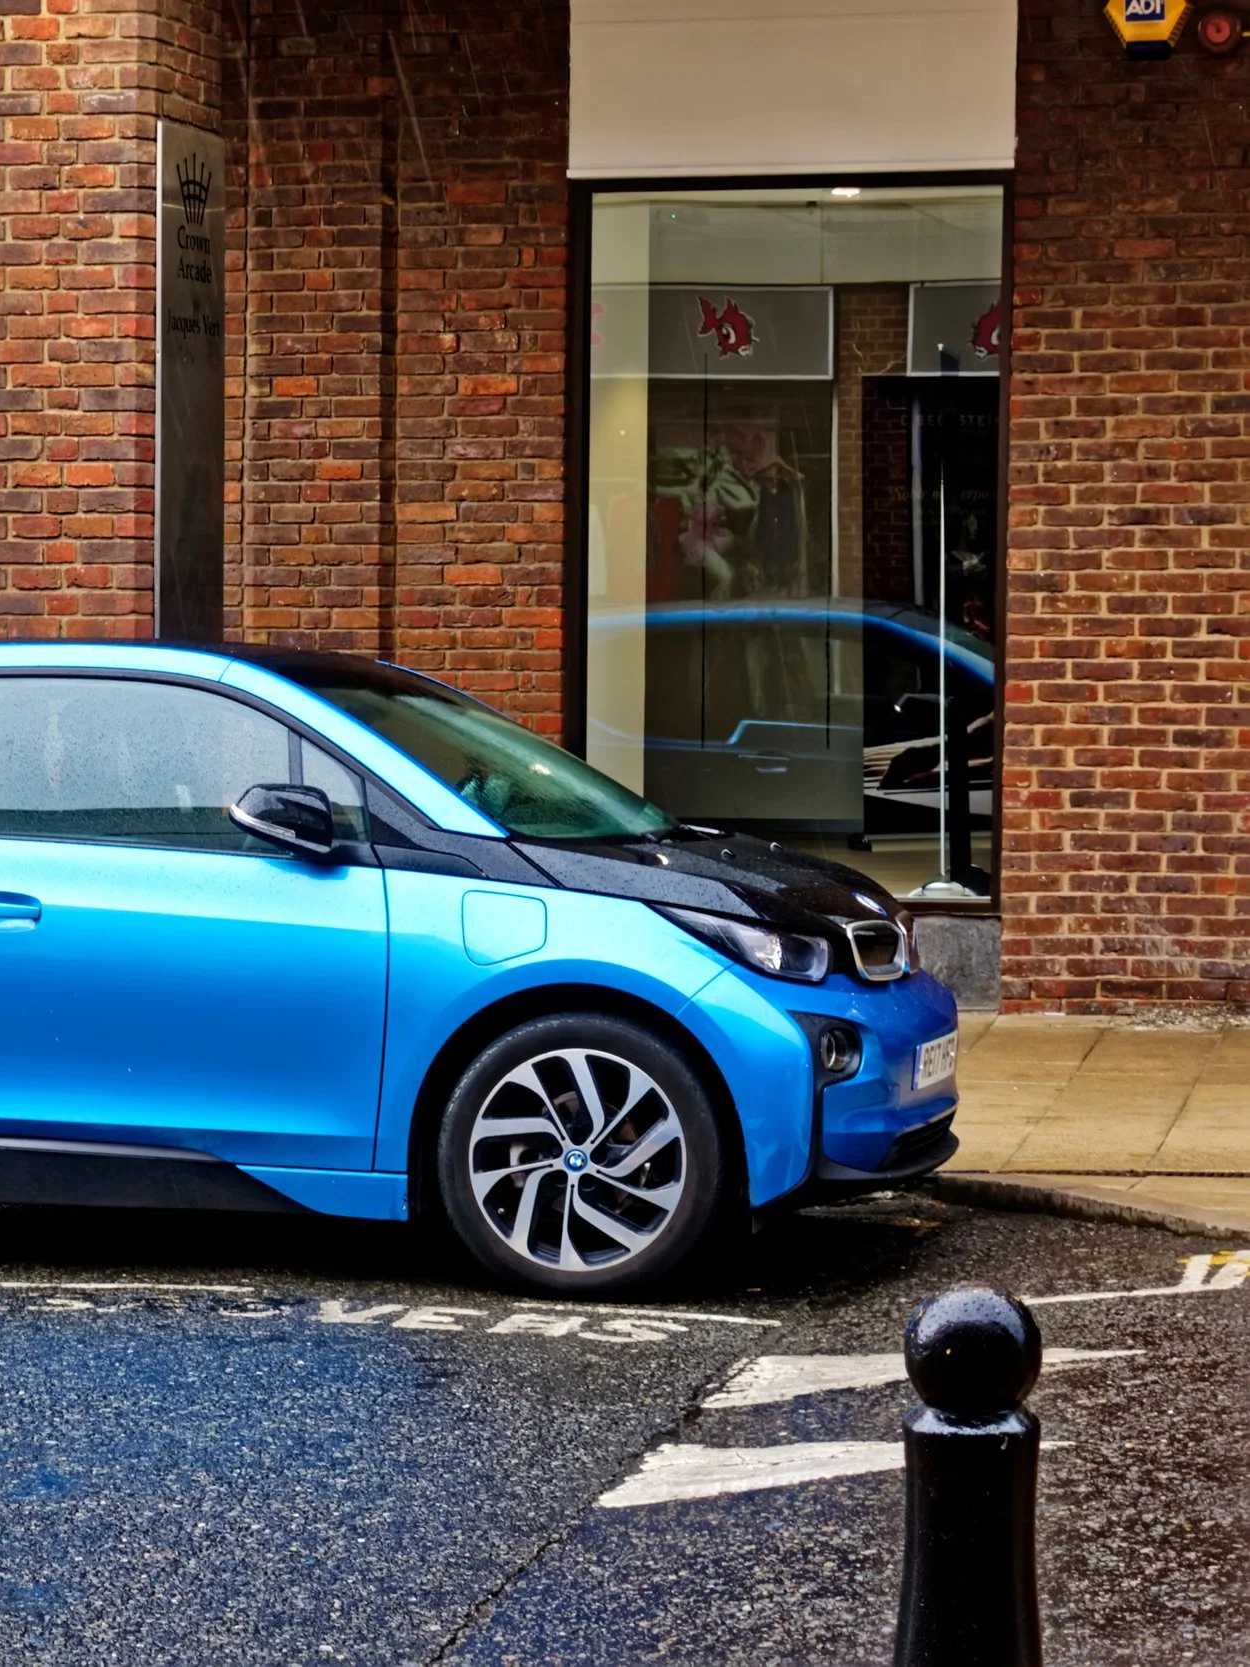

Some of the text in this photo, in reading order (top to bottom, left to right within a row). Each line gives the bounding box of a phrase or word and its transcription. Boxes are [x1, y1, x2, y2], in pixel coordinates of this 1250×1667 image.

[177, 225, 211, 256] Crown
[177, 257, 212, 284] Arcade
[167, 309, 201, 339] Jacques
